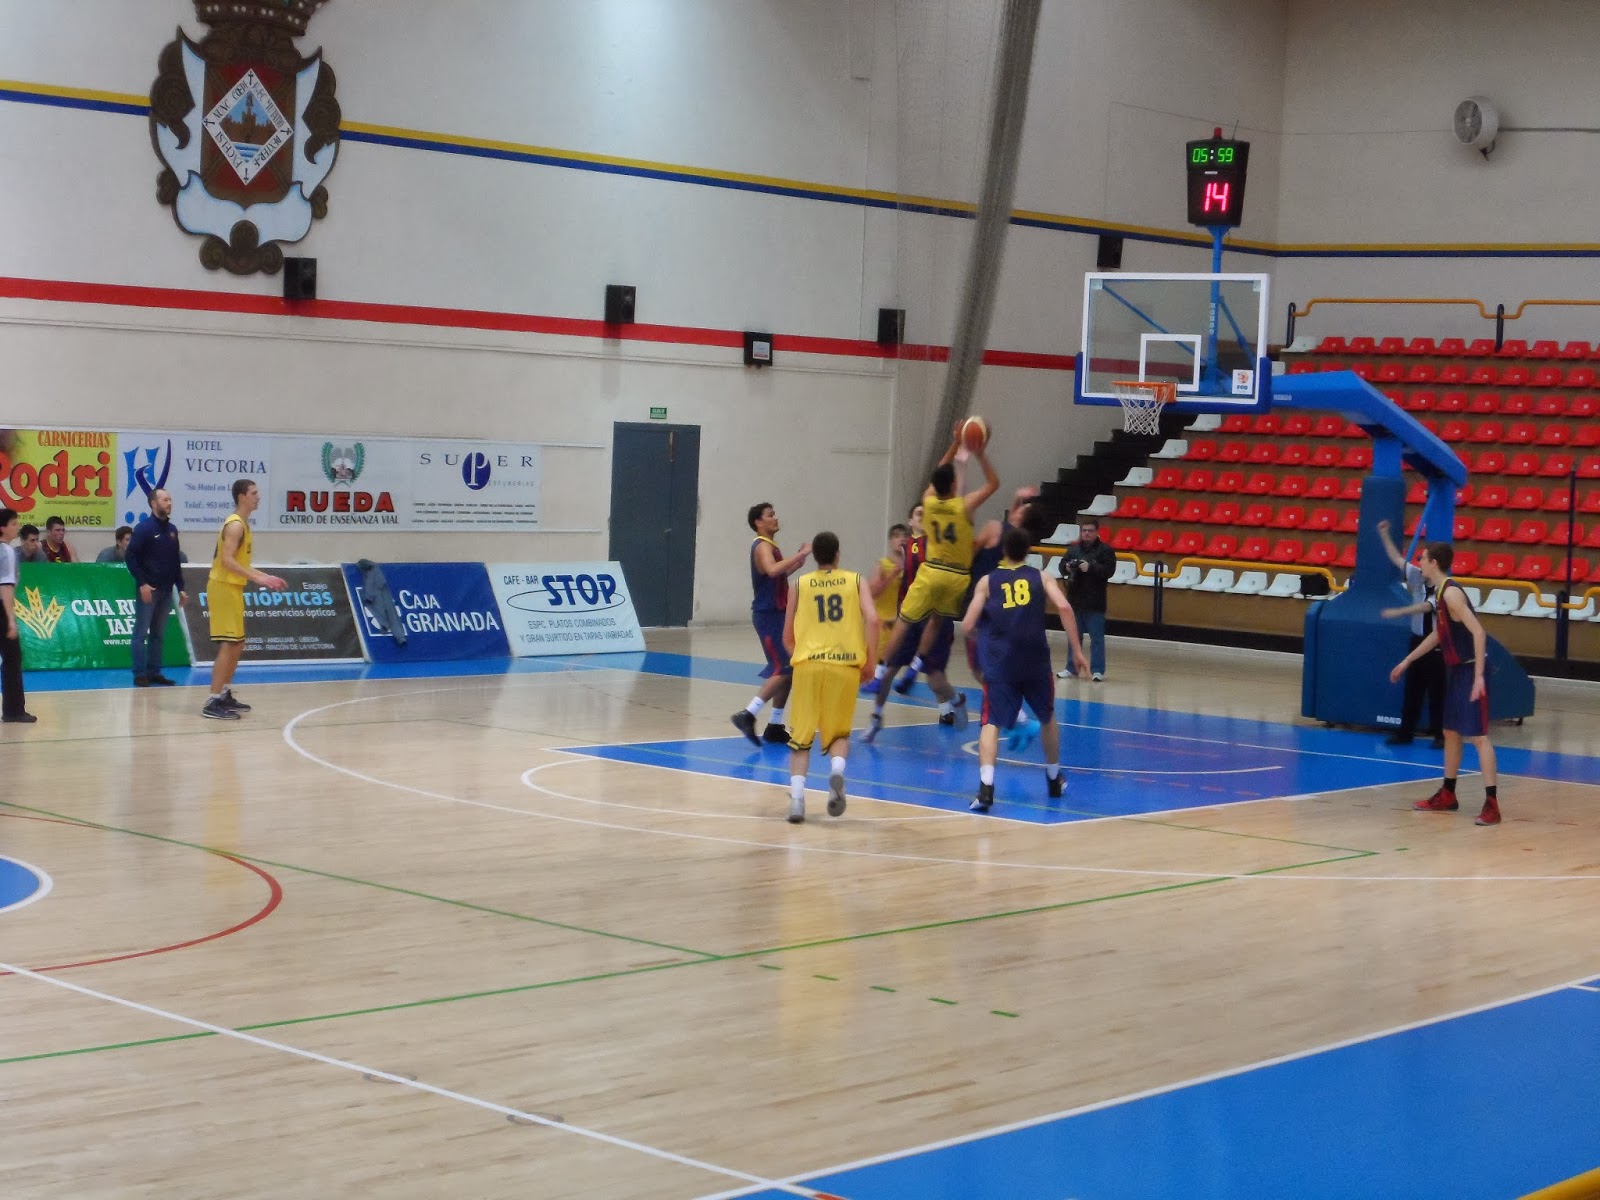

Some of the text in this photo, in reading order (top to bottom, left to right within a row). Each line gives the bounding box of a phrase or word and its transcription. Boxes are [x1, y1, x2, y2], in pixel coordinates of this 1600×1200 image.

[1204, 182, 1229, 212] 14
[186, 440, 223, 451] HOTEL
[185, 458, 267, 474] VICTORIA
[286, 490, 395, 513] RUEDA
[64, 515, 102, 526] INARES
[280, 513, 399, 524] CENTRO DE ENSEÑANZA VIAL
[931, 520, 957, 545] 14
[911, 542, 919, 554] 6
[503, 575, 521, 585] CAFE
[525, 575, 539, 585] BAR
[541, 573, 617, 606] STOP
[1000, 578, 1031, 609] 18
[71, 599, 116, 617] CAJA
[255, 610, 267, 618] en
[267, 608, 305, 618] servicios
[305, 607, 336, 618] ópticos
[814, 593, 844, 623] 18
[406, 611, 500, 632] GRANADA
[549, 619, 574, 628] PLATOS
[573, 617, 617, 628] COMBINADOS
[525, 633, 546, 643] GRAN
[546, 632, 574, 641] SURTIDO
[574, 632, 584, 640] EN
[583, 631, 603, 640] TAPAS
[1376, 715, 1402, 725] MOND
